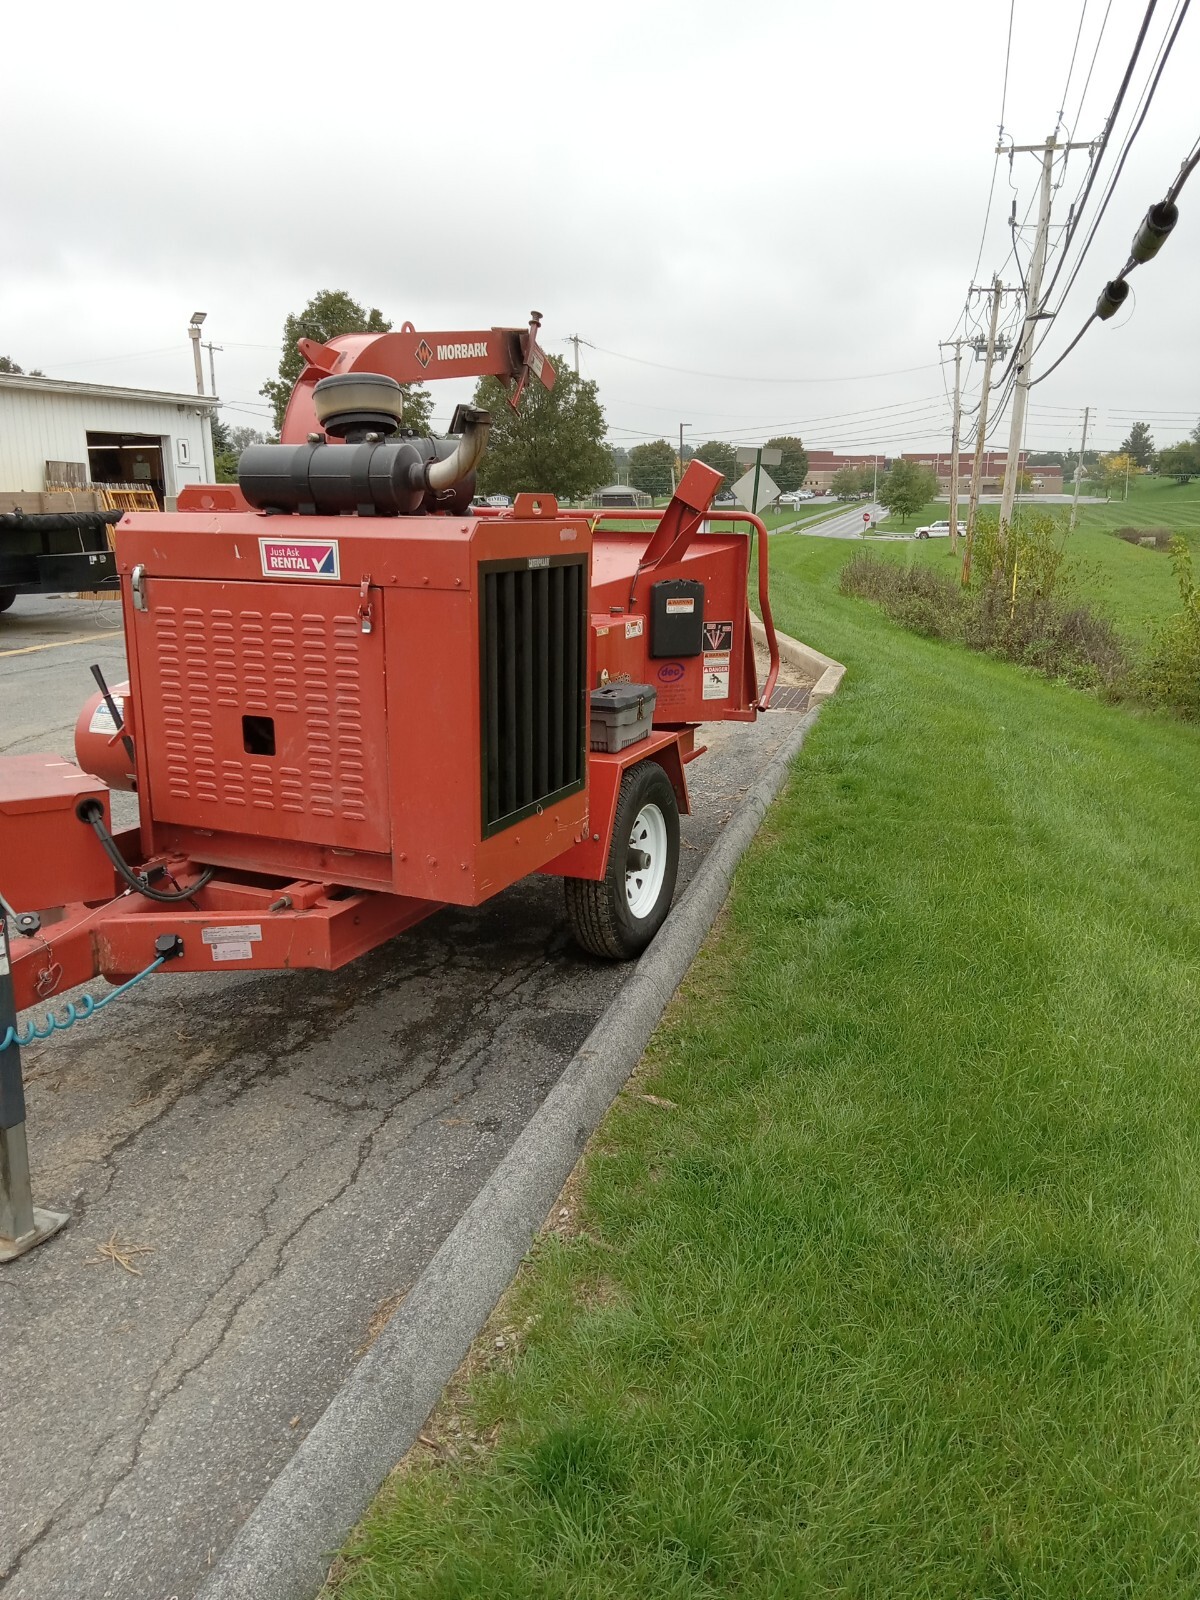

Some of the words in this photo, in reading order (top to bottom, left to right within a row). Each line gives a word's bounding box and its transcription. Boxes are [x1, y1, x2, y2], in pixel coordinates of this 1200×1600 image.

[437, 342, 488, 361] MORBARK
[181, 443, 187, 459] 1
[270, 547, 286, 557] Just
[286, 547, 300, 557] Ask
[270, 556, 311, 570] RENTAL
